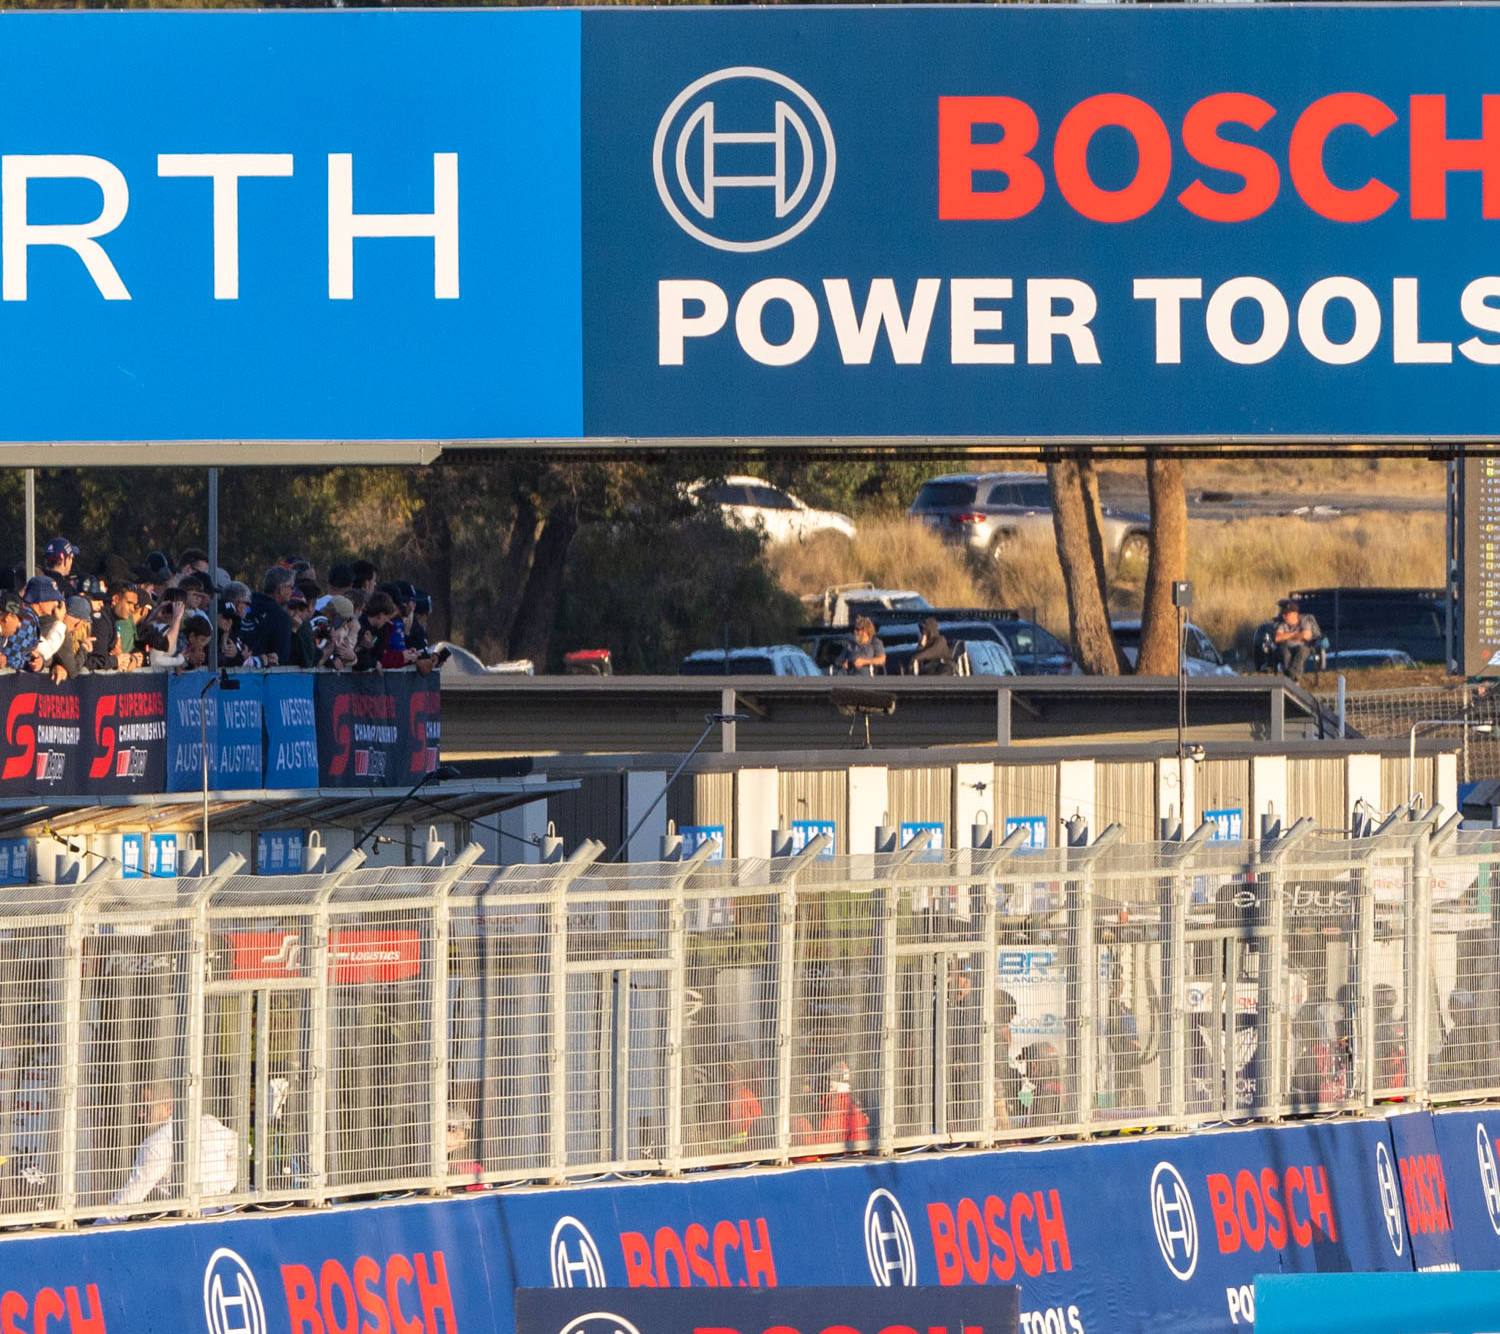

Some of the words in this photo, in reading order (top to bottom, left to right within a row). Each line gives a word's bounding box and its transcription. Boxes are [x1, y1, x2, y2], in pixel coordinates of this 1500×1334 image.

[3, 154, 460, 302] RTH
[660, 279, 1102, 367] POWER
[37, 725, 80, 745] CHAMPIONSHIP
[38, 694, 80, 720] SUPERCARS
[118, 691, 164, 717] SUPERCARS
[118, 720, 166, 743] CHAMPIONSHIP
[1207, 1164, 1338, 1255] BOSCH
[1401, 1156, 1453, 1235] BOSCH
[622, 1220, 777, 1287] BOSCH
[926, 1188, 1072, 1286] BOSCH
